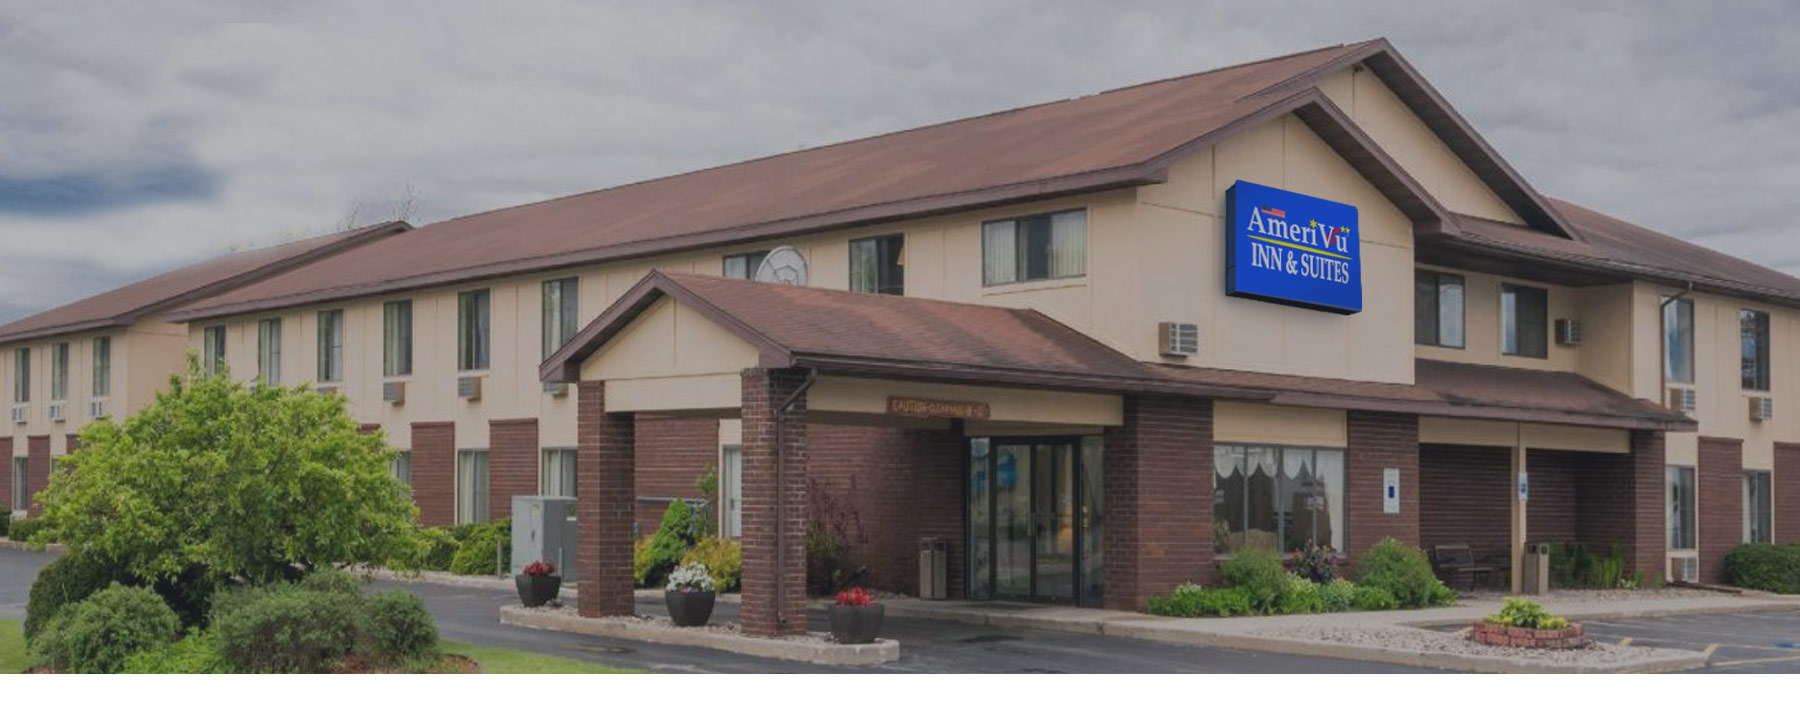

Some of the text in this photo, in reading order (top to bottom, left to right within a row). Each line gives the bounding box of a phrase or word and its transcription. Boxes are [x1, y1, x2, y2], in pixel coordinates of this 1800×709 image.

[1247, 206, 1349, 253] AmeriVu
[1251, 242, 1349, 284] INN & SUITES
